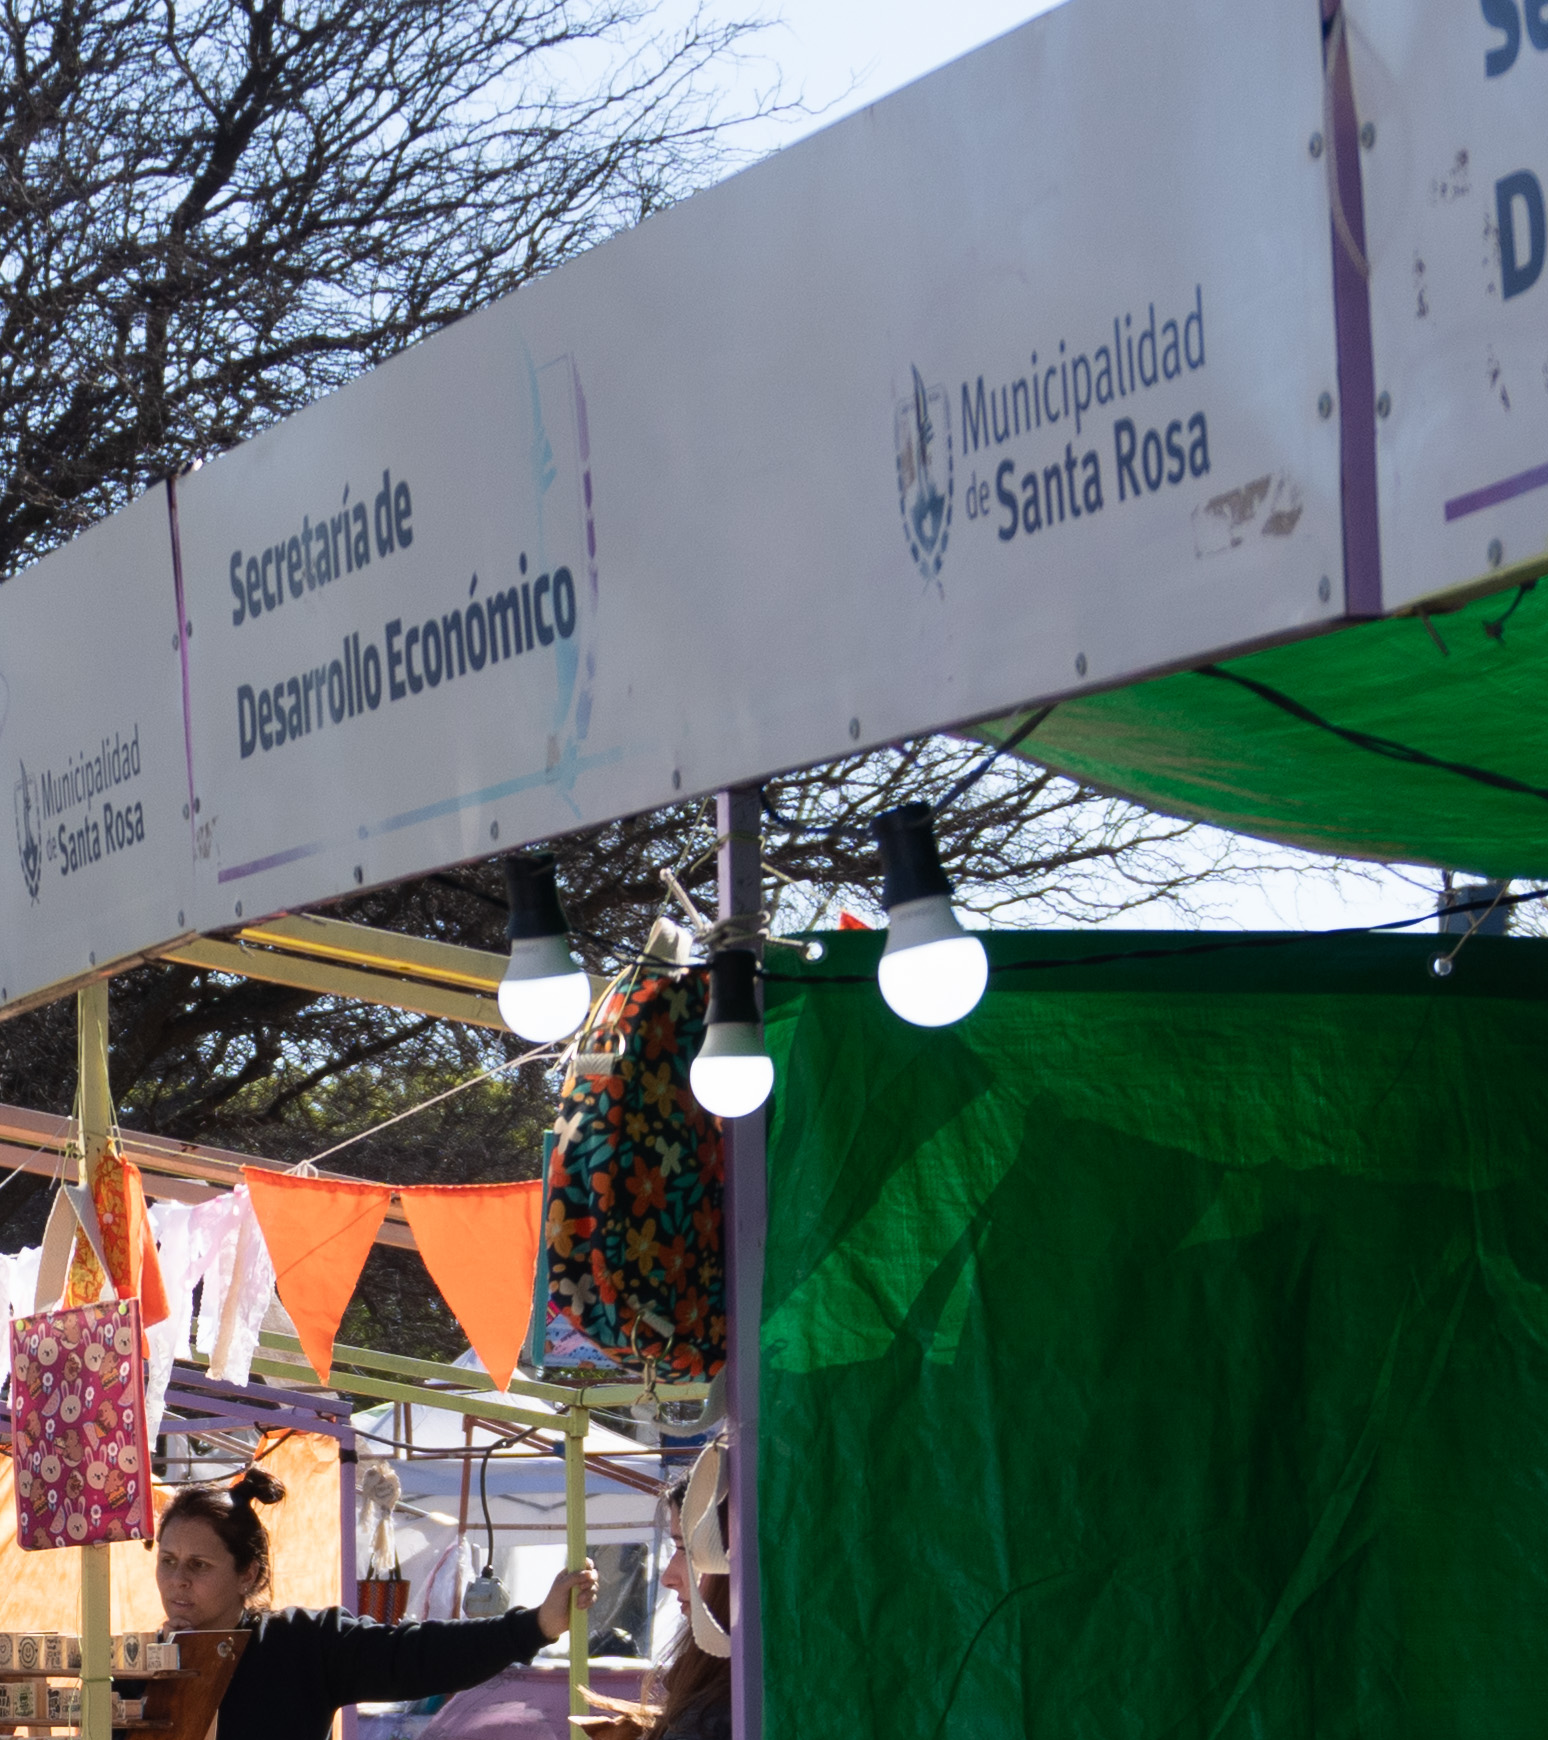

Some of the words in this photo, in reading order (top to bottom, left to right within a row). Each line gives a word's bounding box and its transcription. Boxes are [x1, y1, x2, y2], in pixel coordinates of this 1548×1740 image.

[961, 283, 1206, 455] Municipalidad
[229, 481, 371, 627] Secretaría
[374, 468, 414, 559] de
[965, 469, 991, 521] de
[995, 439, 1105, 542] Santa
[1113, 411, 1211, 502] Rosa
[237, 630, 383, 760] Desarrollo
[384, 551, 578, 702] Económico
[41, 722, 141, 821] Municipalidad
[58, 815, 102, 876] Santa
[103, 801, 145, 855] Rosa
